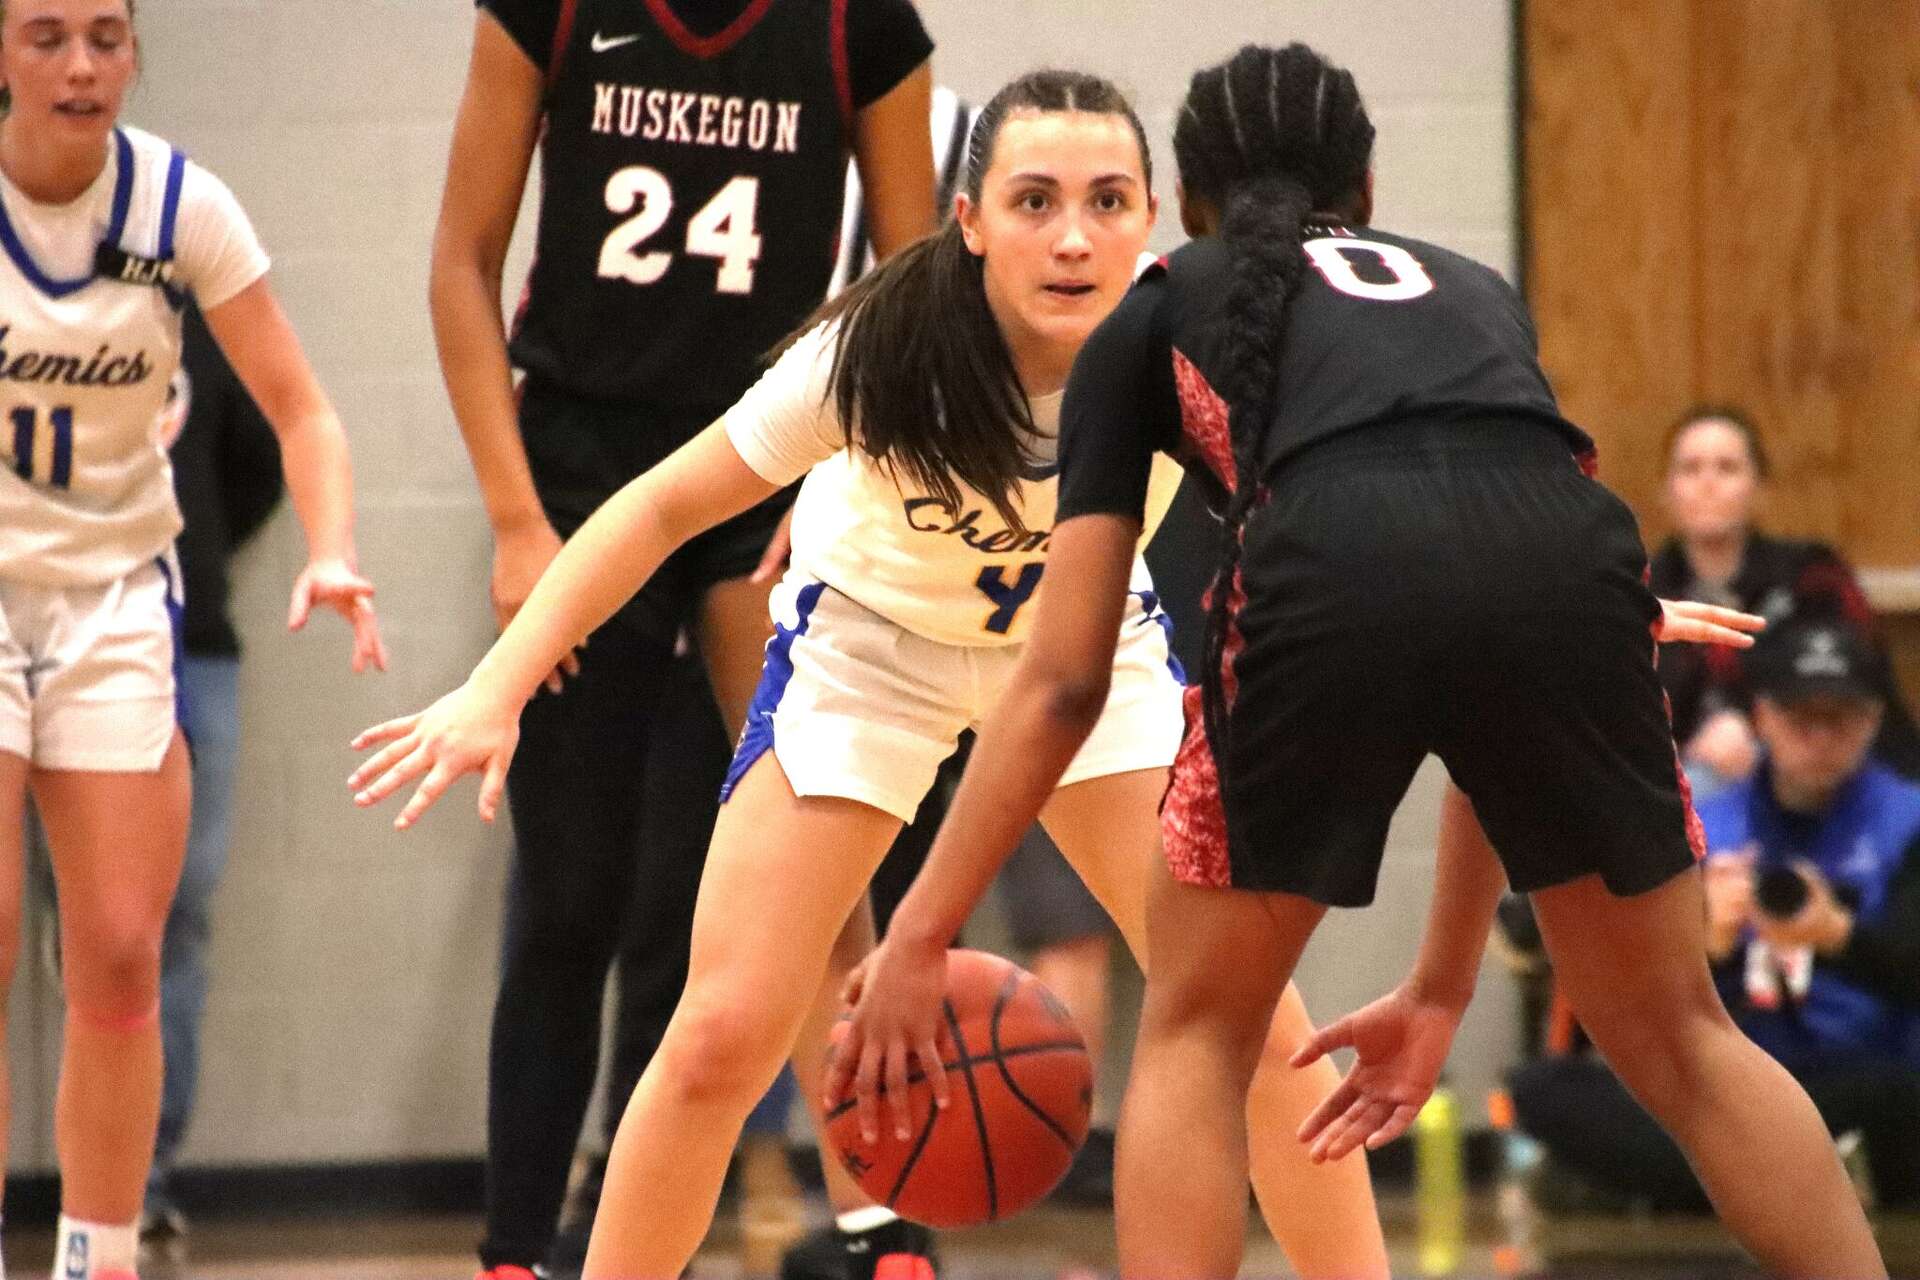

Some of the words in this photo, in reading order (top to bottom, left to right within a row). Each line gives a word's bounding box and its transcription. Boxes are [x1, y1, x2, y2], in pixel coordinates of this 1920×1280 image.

[591, 82, 801, 152] MUSKEGON
[597, 164, 762, 293] 24
[11, 405, 73, 490] 11
